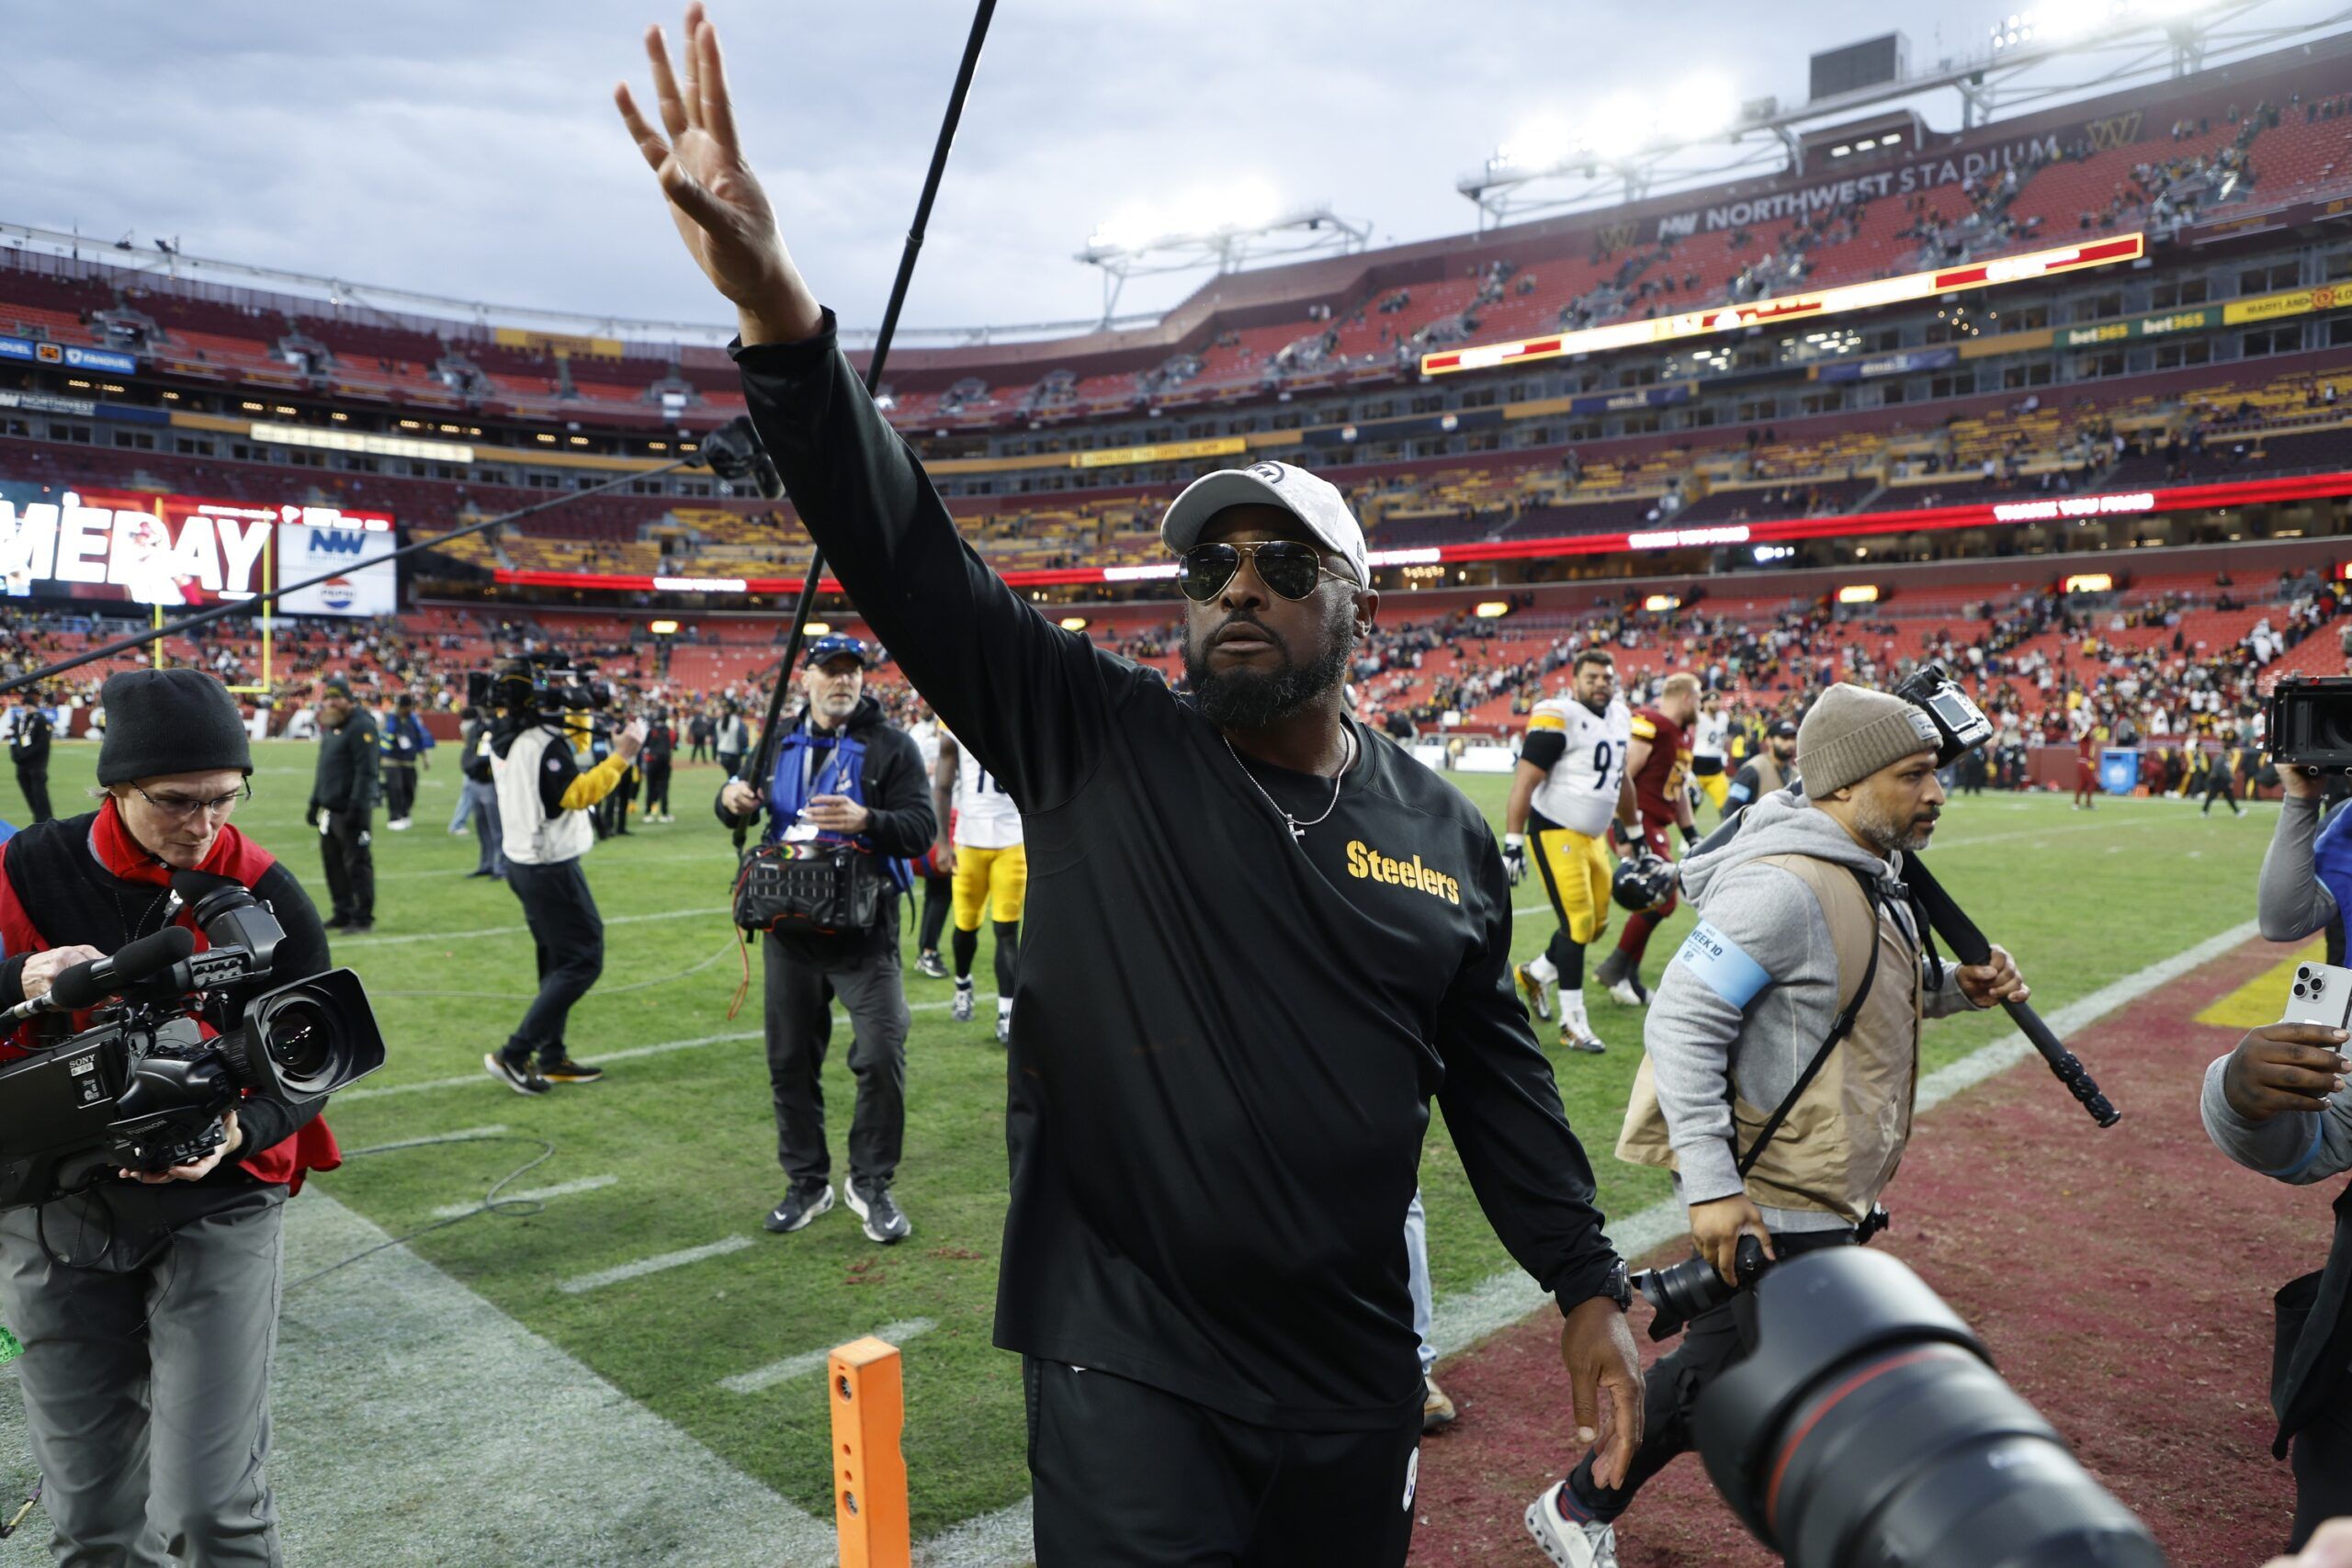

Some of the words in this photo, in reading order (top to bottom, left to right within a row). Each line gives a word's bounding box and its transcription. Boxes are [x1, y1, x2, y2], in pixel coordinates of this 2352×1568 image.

[1706, 172, 1894, 230] NORTHWEST
[1899, 134, 2058, 193] STADIUM
[2068, 322, 2129, 346] bet365
[2142, 311, 2205, 335] bet365
[310, 529, 366, 554] NW
[1346, 840, 1460, 906] Steelers
[1710, 944, 1723, 956] 10
[69, 1054, 96, 1068] SONY
[126, 1119, 167, 1135] FUJINON
